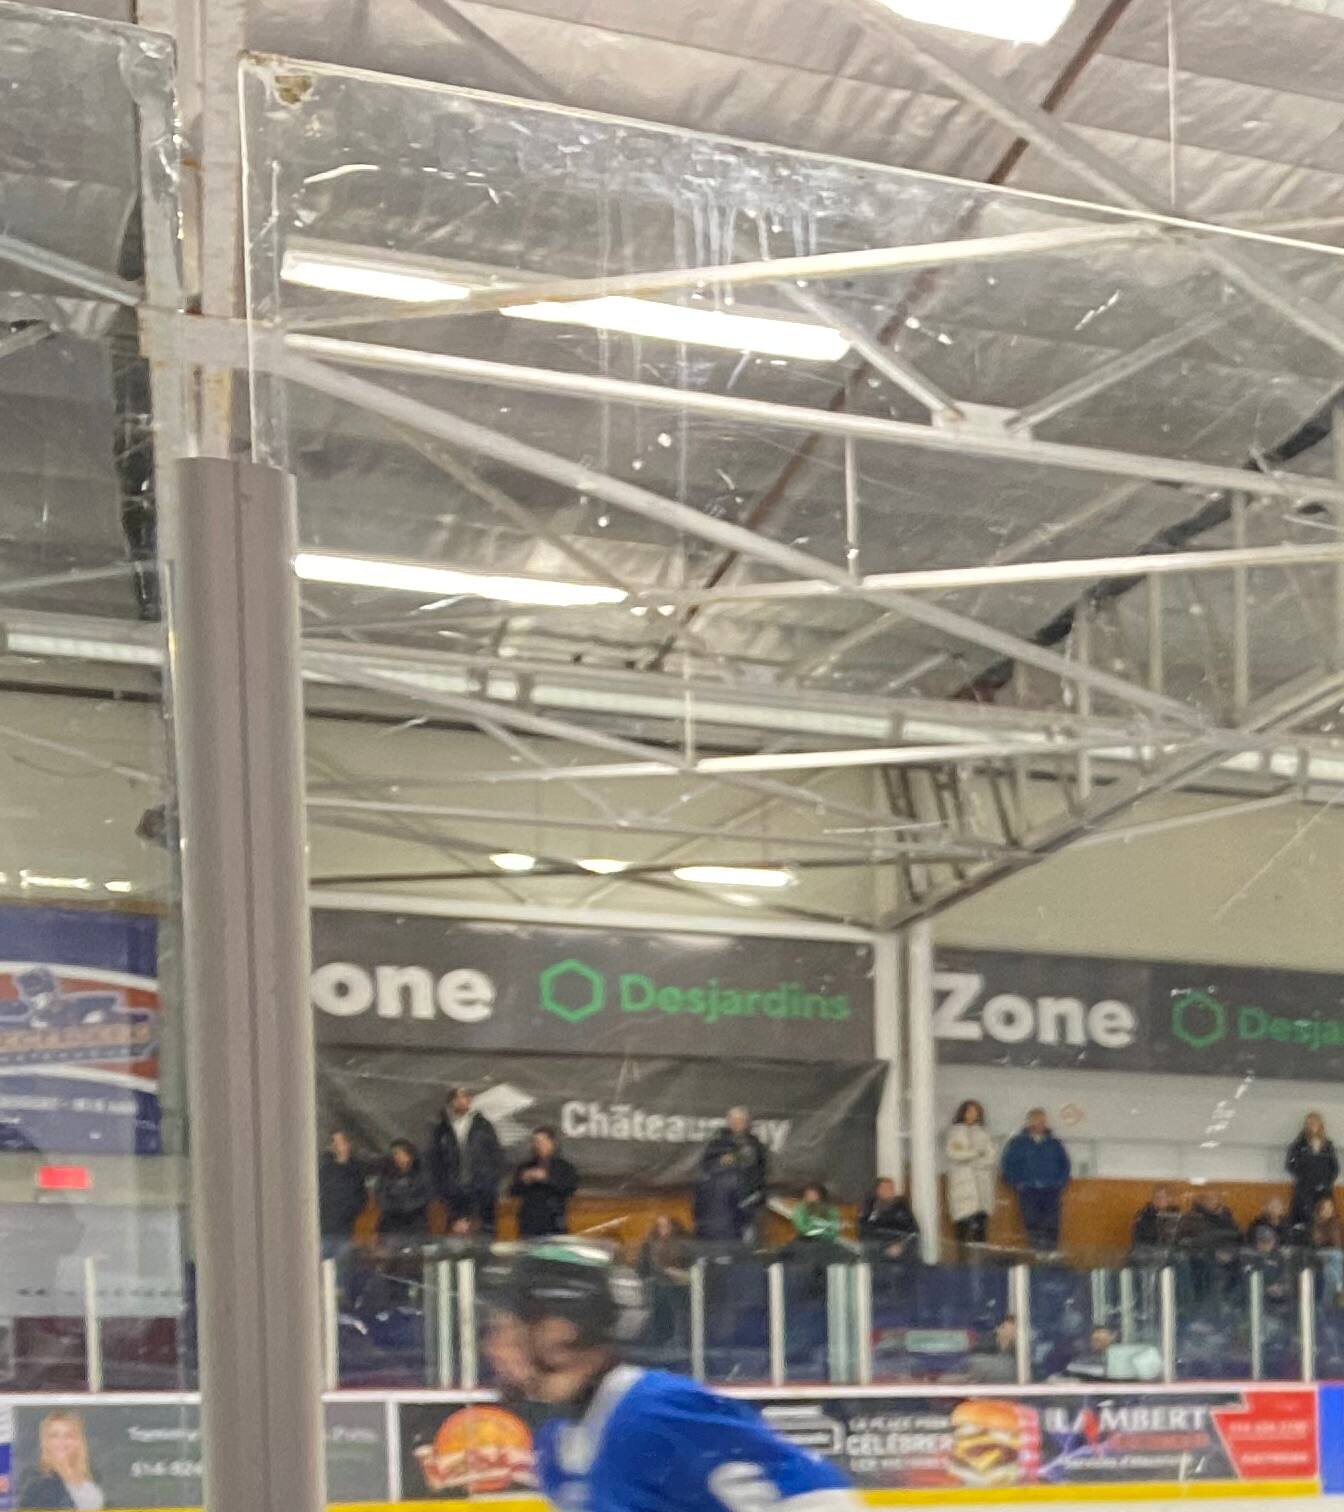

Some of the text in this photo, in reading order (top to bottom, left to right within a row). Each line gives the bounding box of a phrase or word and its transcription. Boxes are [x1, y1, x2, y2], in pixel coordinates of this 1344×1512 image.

[309, 961, 852, 1023] one Desjardins
[933, 970, 1136, 1049] Zone
